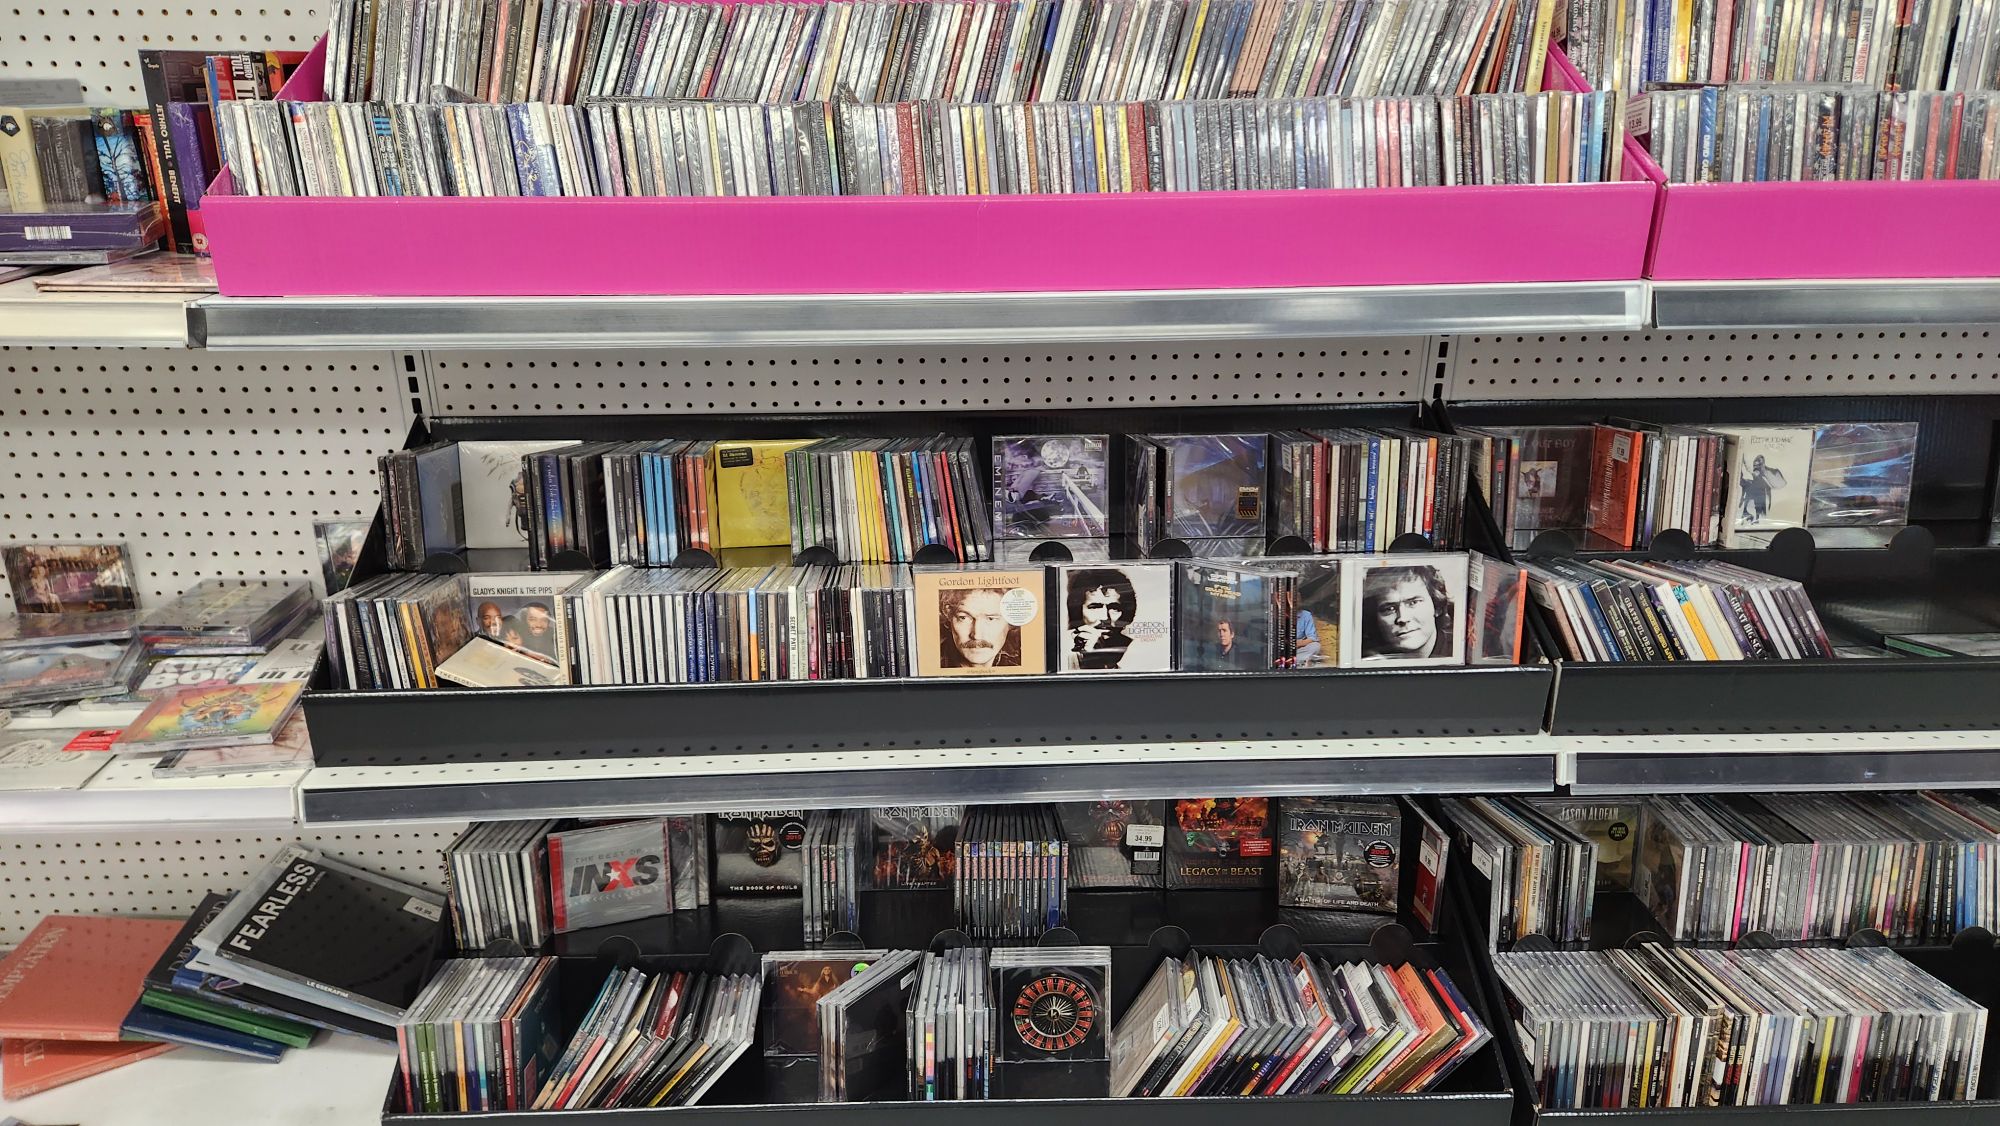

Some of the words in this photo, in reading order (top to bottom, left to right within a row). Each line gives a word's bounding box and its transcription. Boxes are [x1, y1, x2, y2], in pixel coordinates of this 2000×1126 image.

[1863, 7, 1873, 21] BILL
[231, 54, 242, 78] TULL
[242, 53, 252, 79] JETHRO
[1853, 43, 1868, 81] TREASURES
[156, 104, 168, 138] JETHRO
[161, 139, 171, 160] TULL
[1702, 135, 1711, 158] DAVID
[1701, 159, 1710, 183] GUETTA
[169, 170, 182, 205] BENEFIT
[993, 454, 1002, 523] EMINEM
[473, 587, 496, 596] GLADYS
[497, 587, 518, 595] KNIGHT
[525, 586, 537, 595] THE
[538, 586, 553, 595] PIPS
[938, 576, 975, 587] Gordon
[977, 575, 1020, 587] Lightfoot
[556, 613, 564, 644] GLORIOUS
[789, 616, 797, 636] SECRET
[1128, 626, 1168, 635] LIGHTFOOT
[1133, 620, 1165, 629] GORDON
[1623, 596, 1644, 636] GRATEFUL
[1635, 636, 1655, 656] DEAD
[1729, 597, 1748, 625] GREAT
[1743, 624, 1756, 639] BIG
[1750, 638, 1763, 656] SEA
[697, 623, 705, 660] GODSMACK
[790, 637, 798, 651] PATH
[878, 806, 909, 820] IRON
[912, 806, 959, 820] MAIDEN
[1559, 806, 1587, 822] JASON
[1588, 806, 1619, 821] ALDEAN
[1290, 817, 1329, 834] IRON
[1331, 817, 1392, 837] MAIDEN
[1134, 834, 1153, 844] 34.99
[575, 855, 594, 864] THE
[599, 851, 627, 861] BEST
[629, 850, 642, 858] OF
[569, 853, 661, 898] INXS
[1180, 868, 1221, 877] LEGACY
[1230, 867, 1264, 876] BEAST
[230, 863, 317, 951] FEARLESS
[1359, 900, 1379, 908] DEATH
[1930, 1066, 1942, 1096] METEORA
[1969, 1064, 1980, 1092] METEORA
